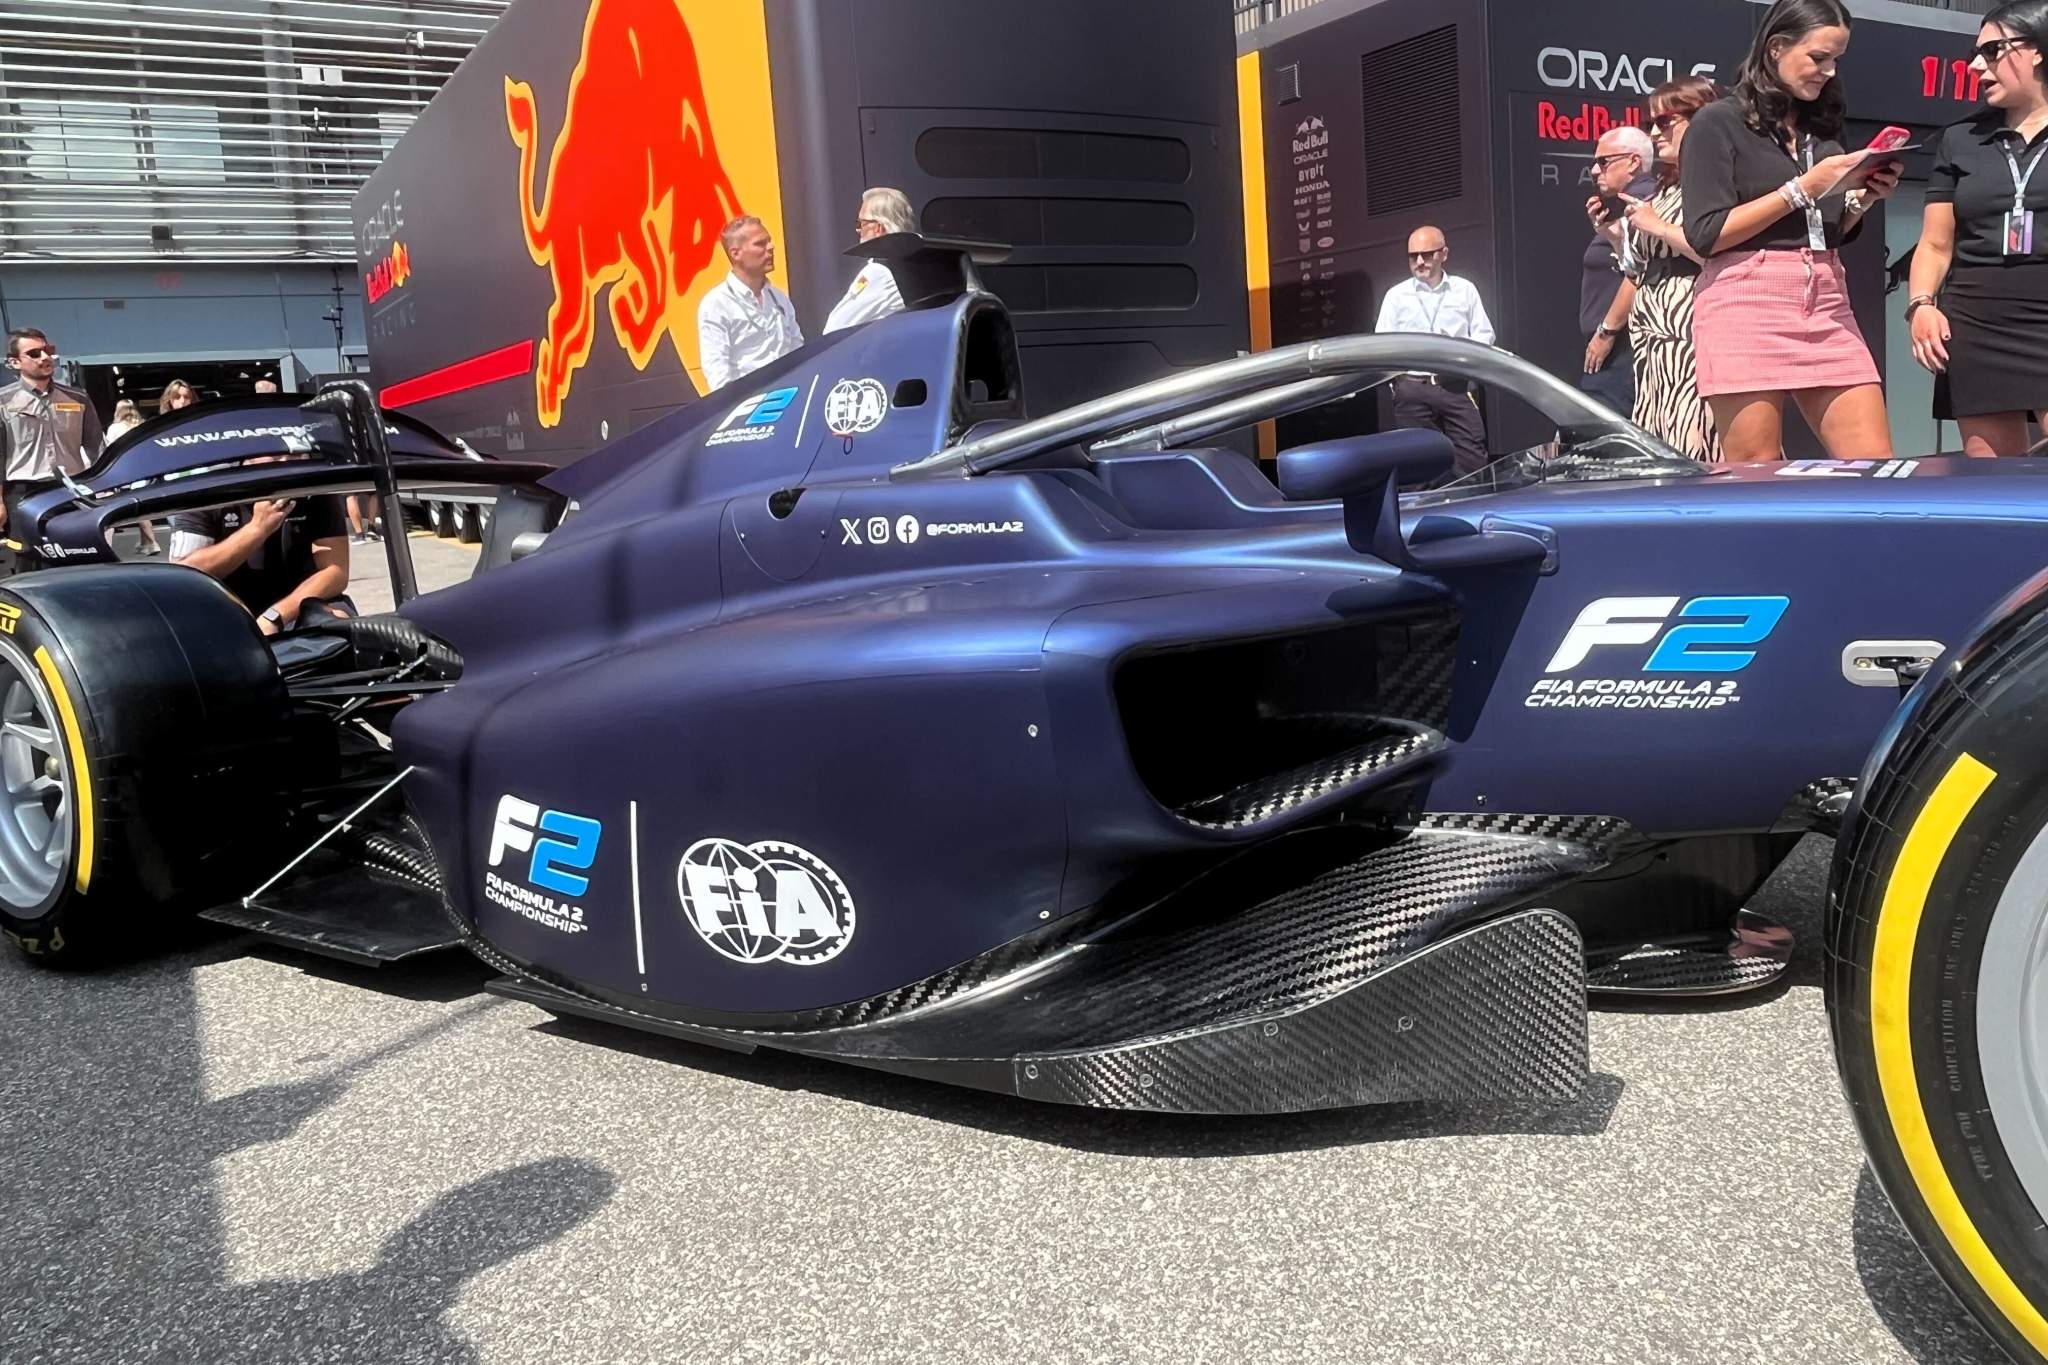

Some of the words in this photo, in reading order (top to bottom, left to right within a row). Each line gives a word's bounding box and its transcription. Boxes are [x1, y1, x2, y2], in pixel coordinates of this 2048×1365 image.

[716, 386, 799, 431] F2
[926, 521, 1024, 536] @FORMULA2
[1545, 595, 1791, 673] F2
[1531, 679, 1576, 694] FIA
[1576, 679, 1710, 695] FORMULA
[1715, 680, 1737, 695] 2
[488, 794, 602, 897] F2
[503, 881, 570, 919] FORMULA
[571, 906, 584, 922] 2
